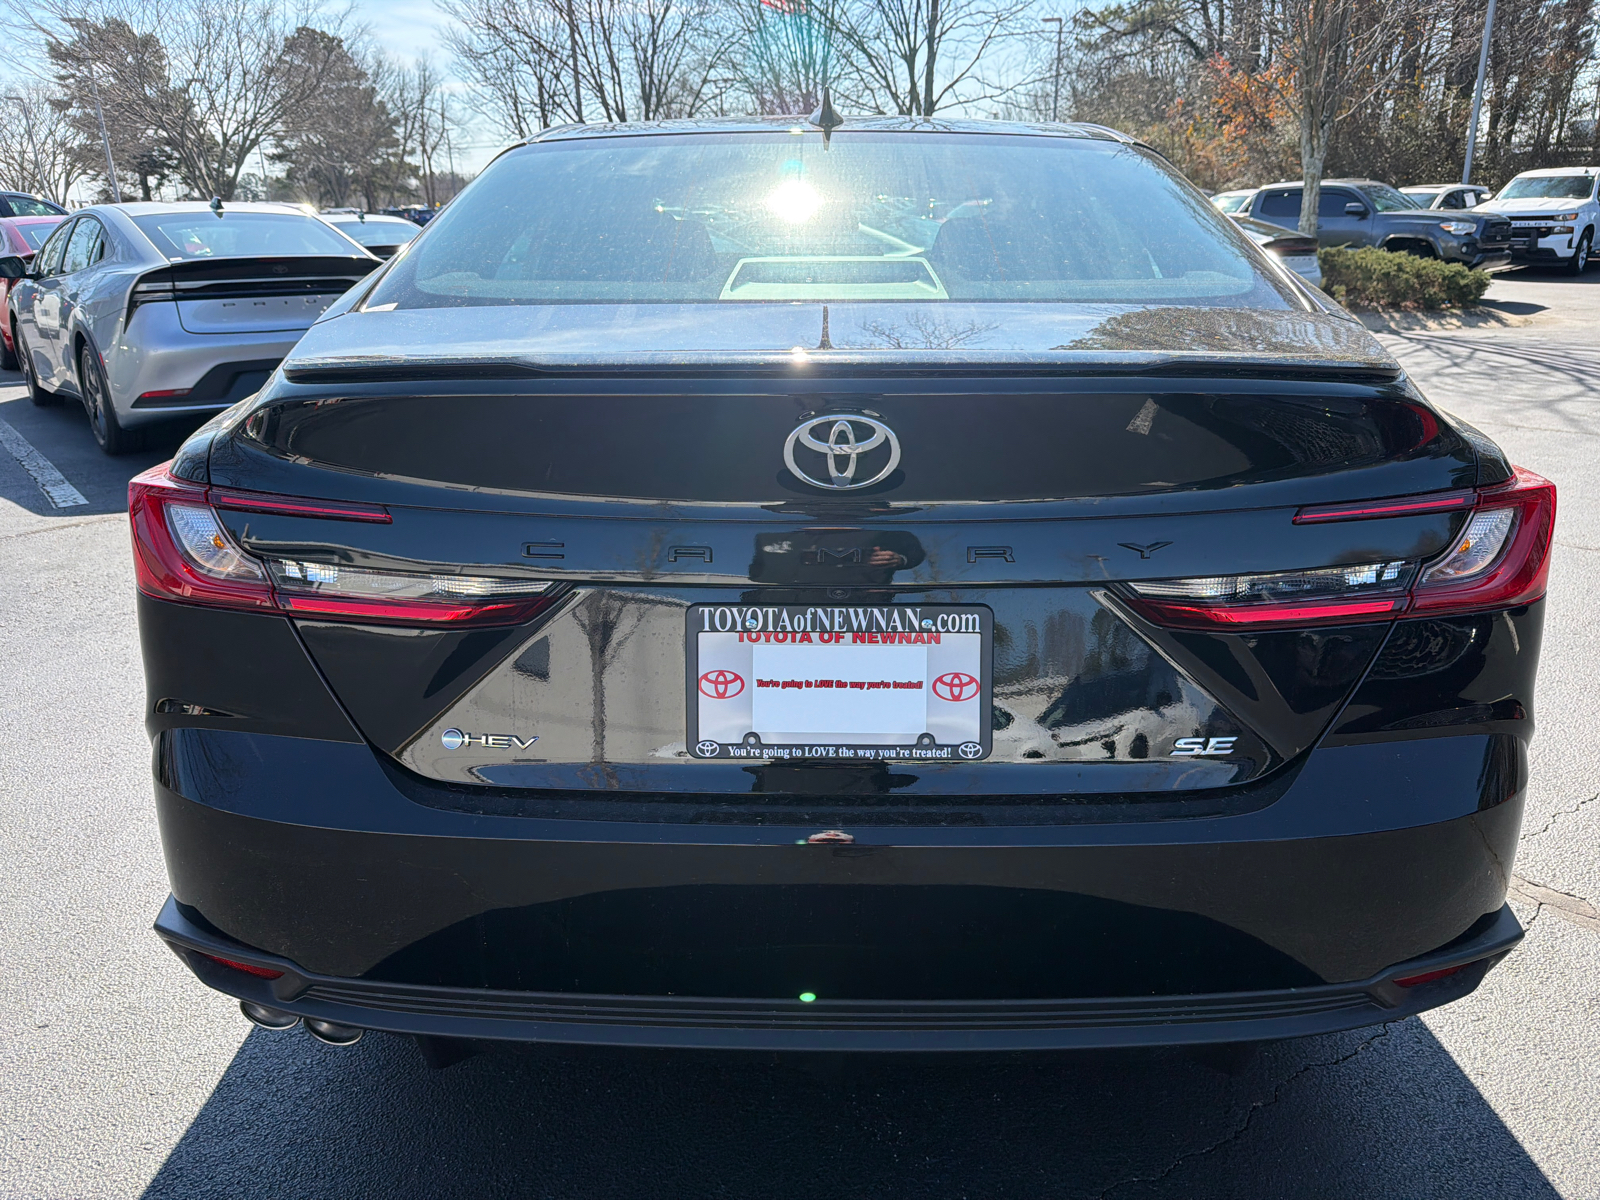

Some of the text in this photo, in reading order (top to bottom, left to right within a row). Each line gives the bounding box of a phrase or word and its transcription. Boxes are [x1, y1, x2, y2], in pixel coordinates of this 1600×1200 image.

[520, 541, 1174, 563] CAMRY
[737, 631, 942, 645] TOYOTA OF NEWNAN
[756, 679, 924, 690] You're going to LOVE the way you're treated!
[727, 745, 952, 760] You're going to LOVE the way you're treated!
[1169, 736, 1239, 757] SE
